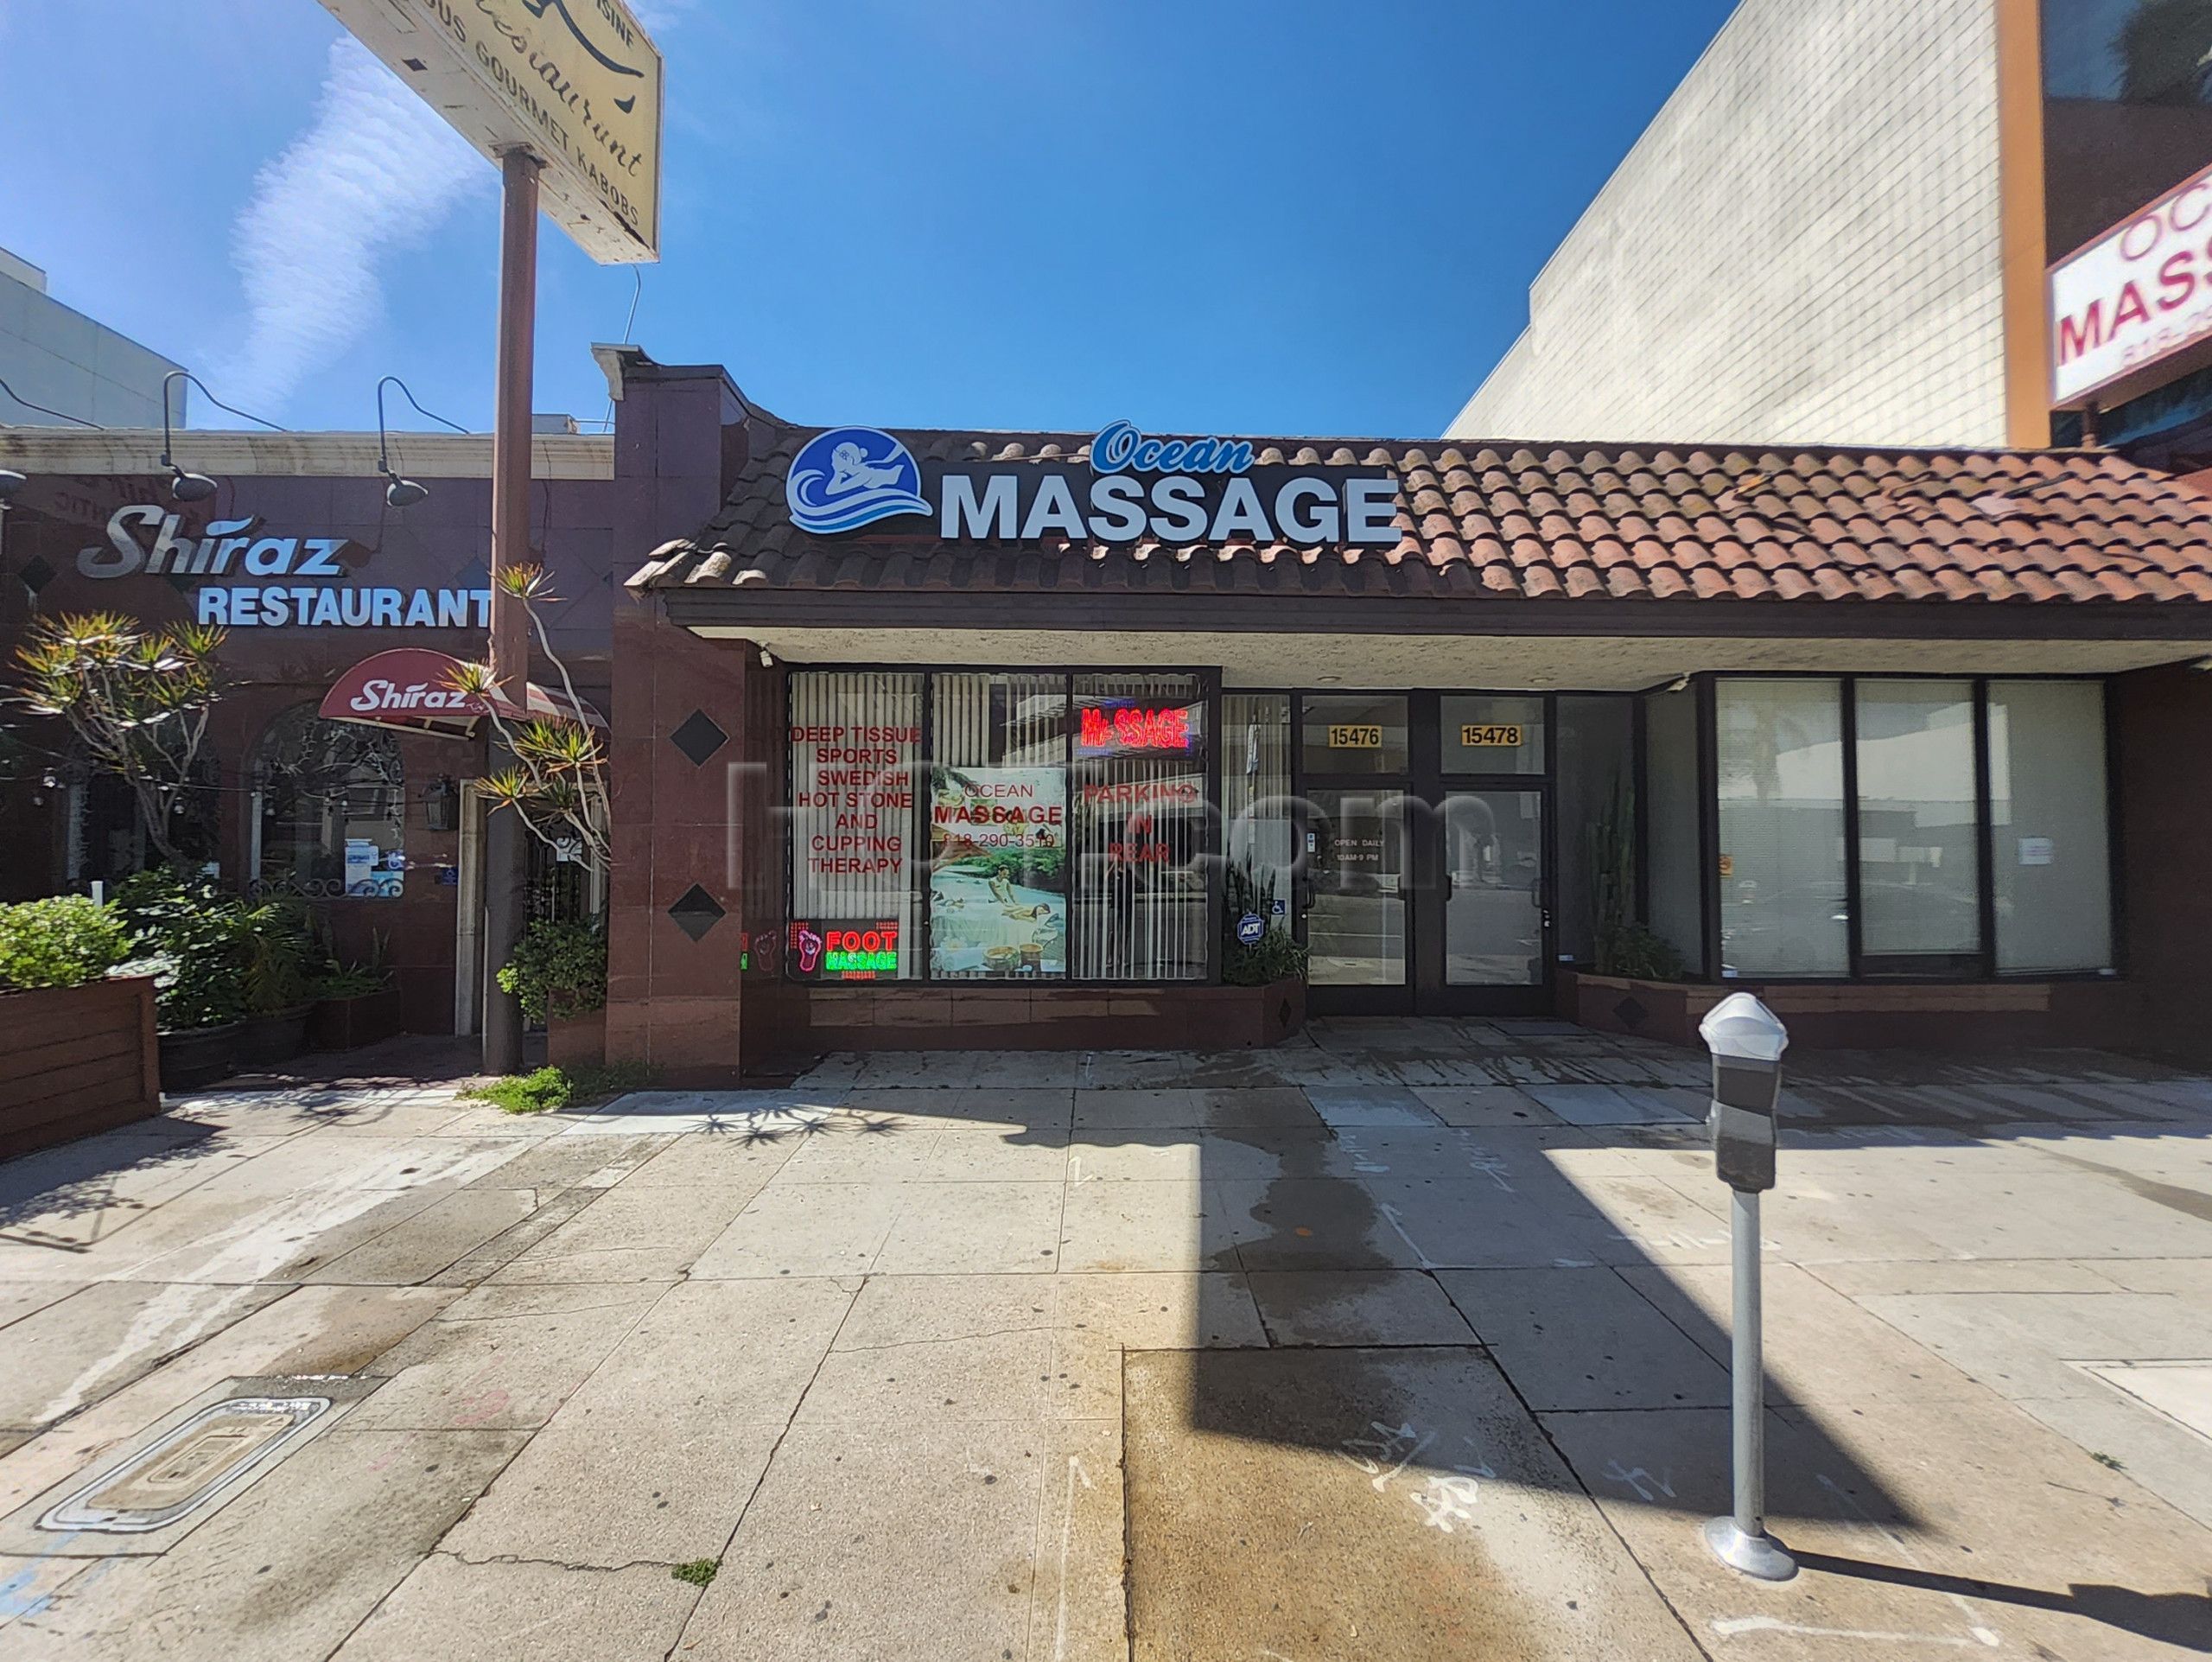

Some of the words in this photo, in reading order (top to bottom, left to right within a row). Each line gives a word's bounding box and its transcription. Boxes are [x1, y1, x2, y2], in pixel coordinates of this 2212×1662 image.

[475, 40, 569, 151] GOURMET
[575, 145, 639, 226] KABOBS
[2059, 232, 2212, 366] MAS
[1089, 419, 1255, 474] Ocean
[940, 474, 1402, 543] MASSAGE
[76, 504, 349, 579] Shiraz
[198, 586, 492, 627] RESTAURANT
[350, 679, 467, 711] Shiraz
[791, 727, 844, 742] DEEP
[851, 727, 921, 743] TISSUE
[1332, 728, 1379, 746] 15476
[1463, 727, 1518, 744] 15478
[816, 748, 897, 764] SPORTS
[817, 770, 909, 786] SWEDISH
[798, 792, 840, 808] HOT
[846, 792, 912, 809] STONE
[964, 784, 1033, 798] OCEAN
[1084, 783, 1198, 805] PARKING
[835, 813, 878, 830] AND
[934, 805, 1063, 825] MASSAGE
[811, 836, 901, 852] CUPPING
[1109, 843, 1169, 863] REAR
[808, 857, 903, 874] THERAPY
[1241, 922, 1261, 936] ADT
[826, 931, 898, 952] FOOT
